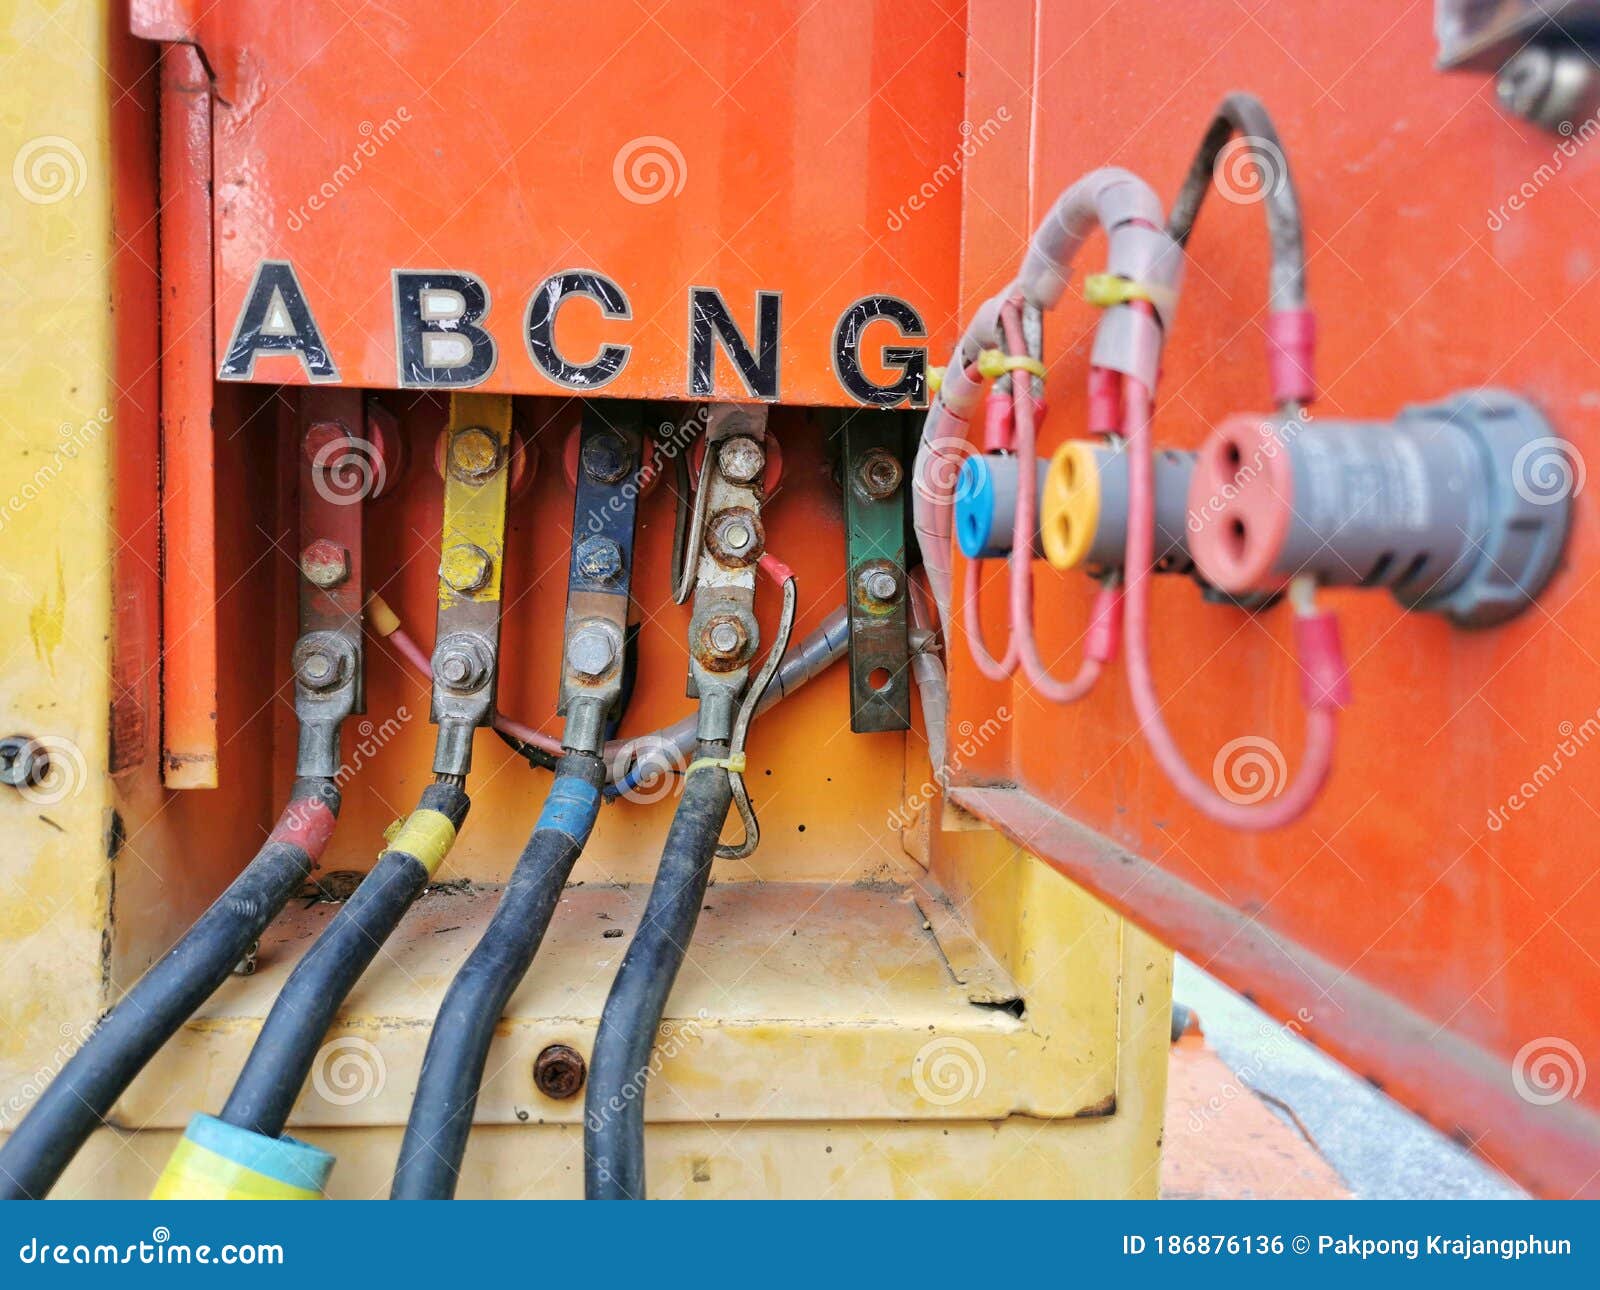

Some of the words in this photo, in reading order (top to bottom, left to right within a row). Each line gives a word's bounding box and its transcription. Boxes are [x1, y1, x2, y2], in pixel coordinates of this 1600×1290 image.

[216, 260, 342, 383] A
[391, 268, 498, 390] B
[523, 268, 633, 391] C
[687, 286, 783, 400] N
[831, 294, 929, 410] G
